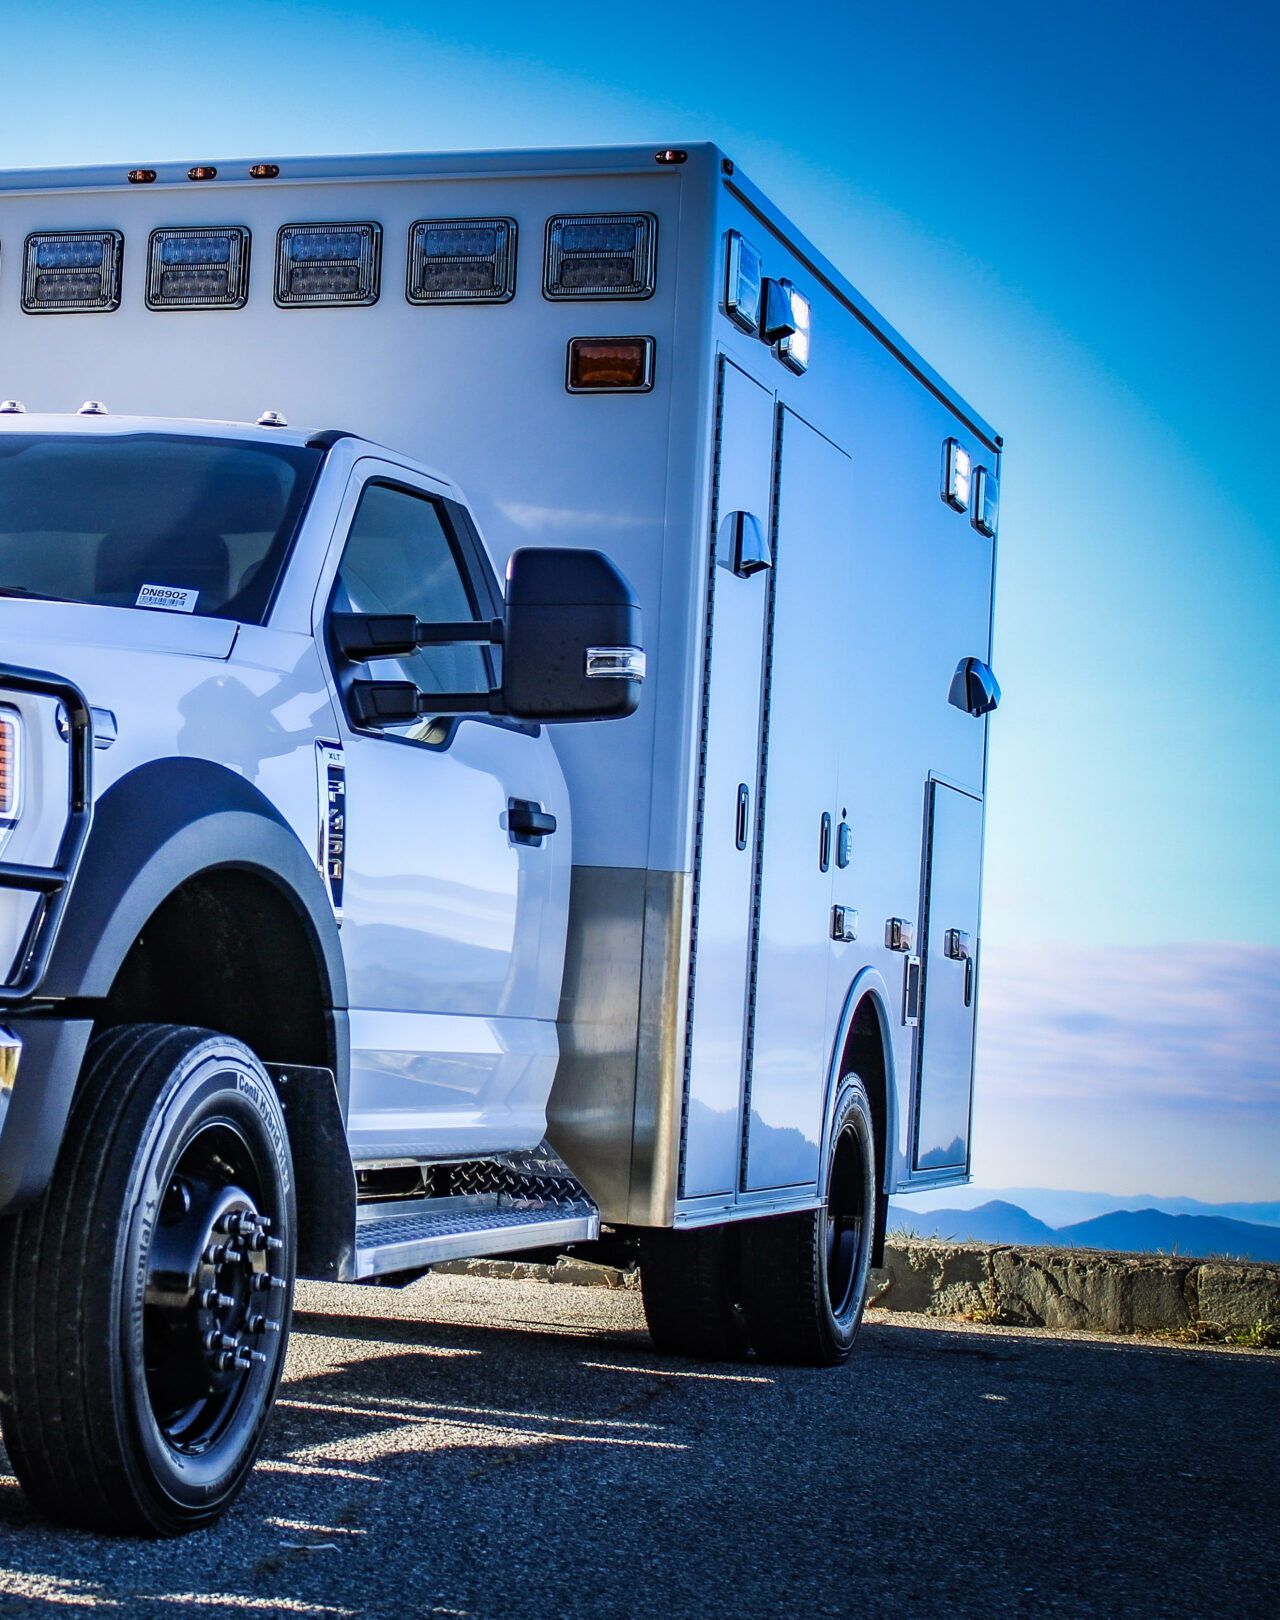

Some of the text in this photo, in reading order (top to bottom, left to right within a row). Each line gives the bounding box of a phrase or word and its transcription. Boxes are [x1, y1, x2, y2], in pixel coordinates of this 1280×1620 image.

[141, 587, 188, 601] DN8902
[328, 752, 341, 761] XLT
[238, 1074, 260, 1104] Conti
[259, 1098, 281, 1149] Hybrid
